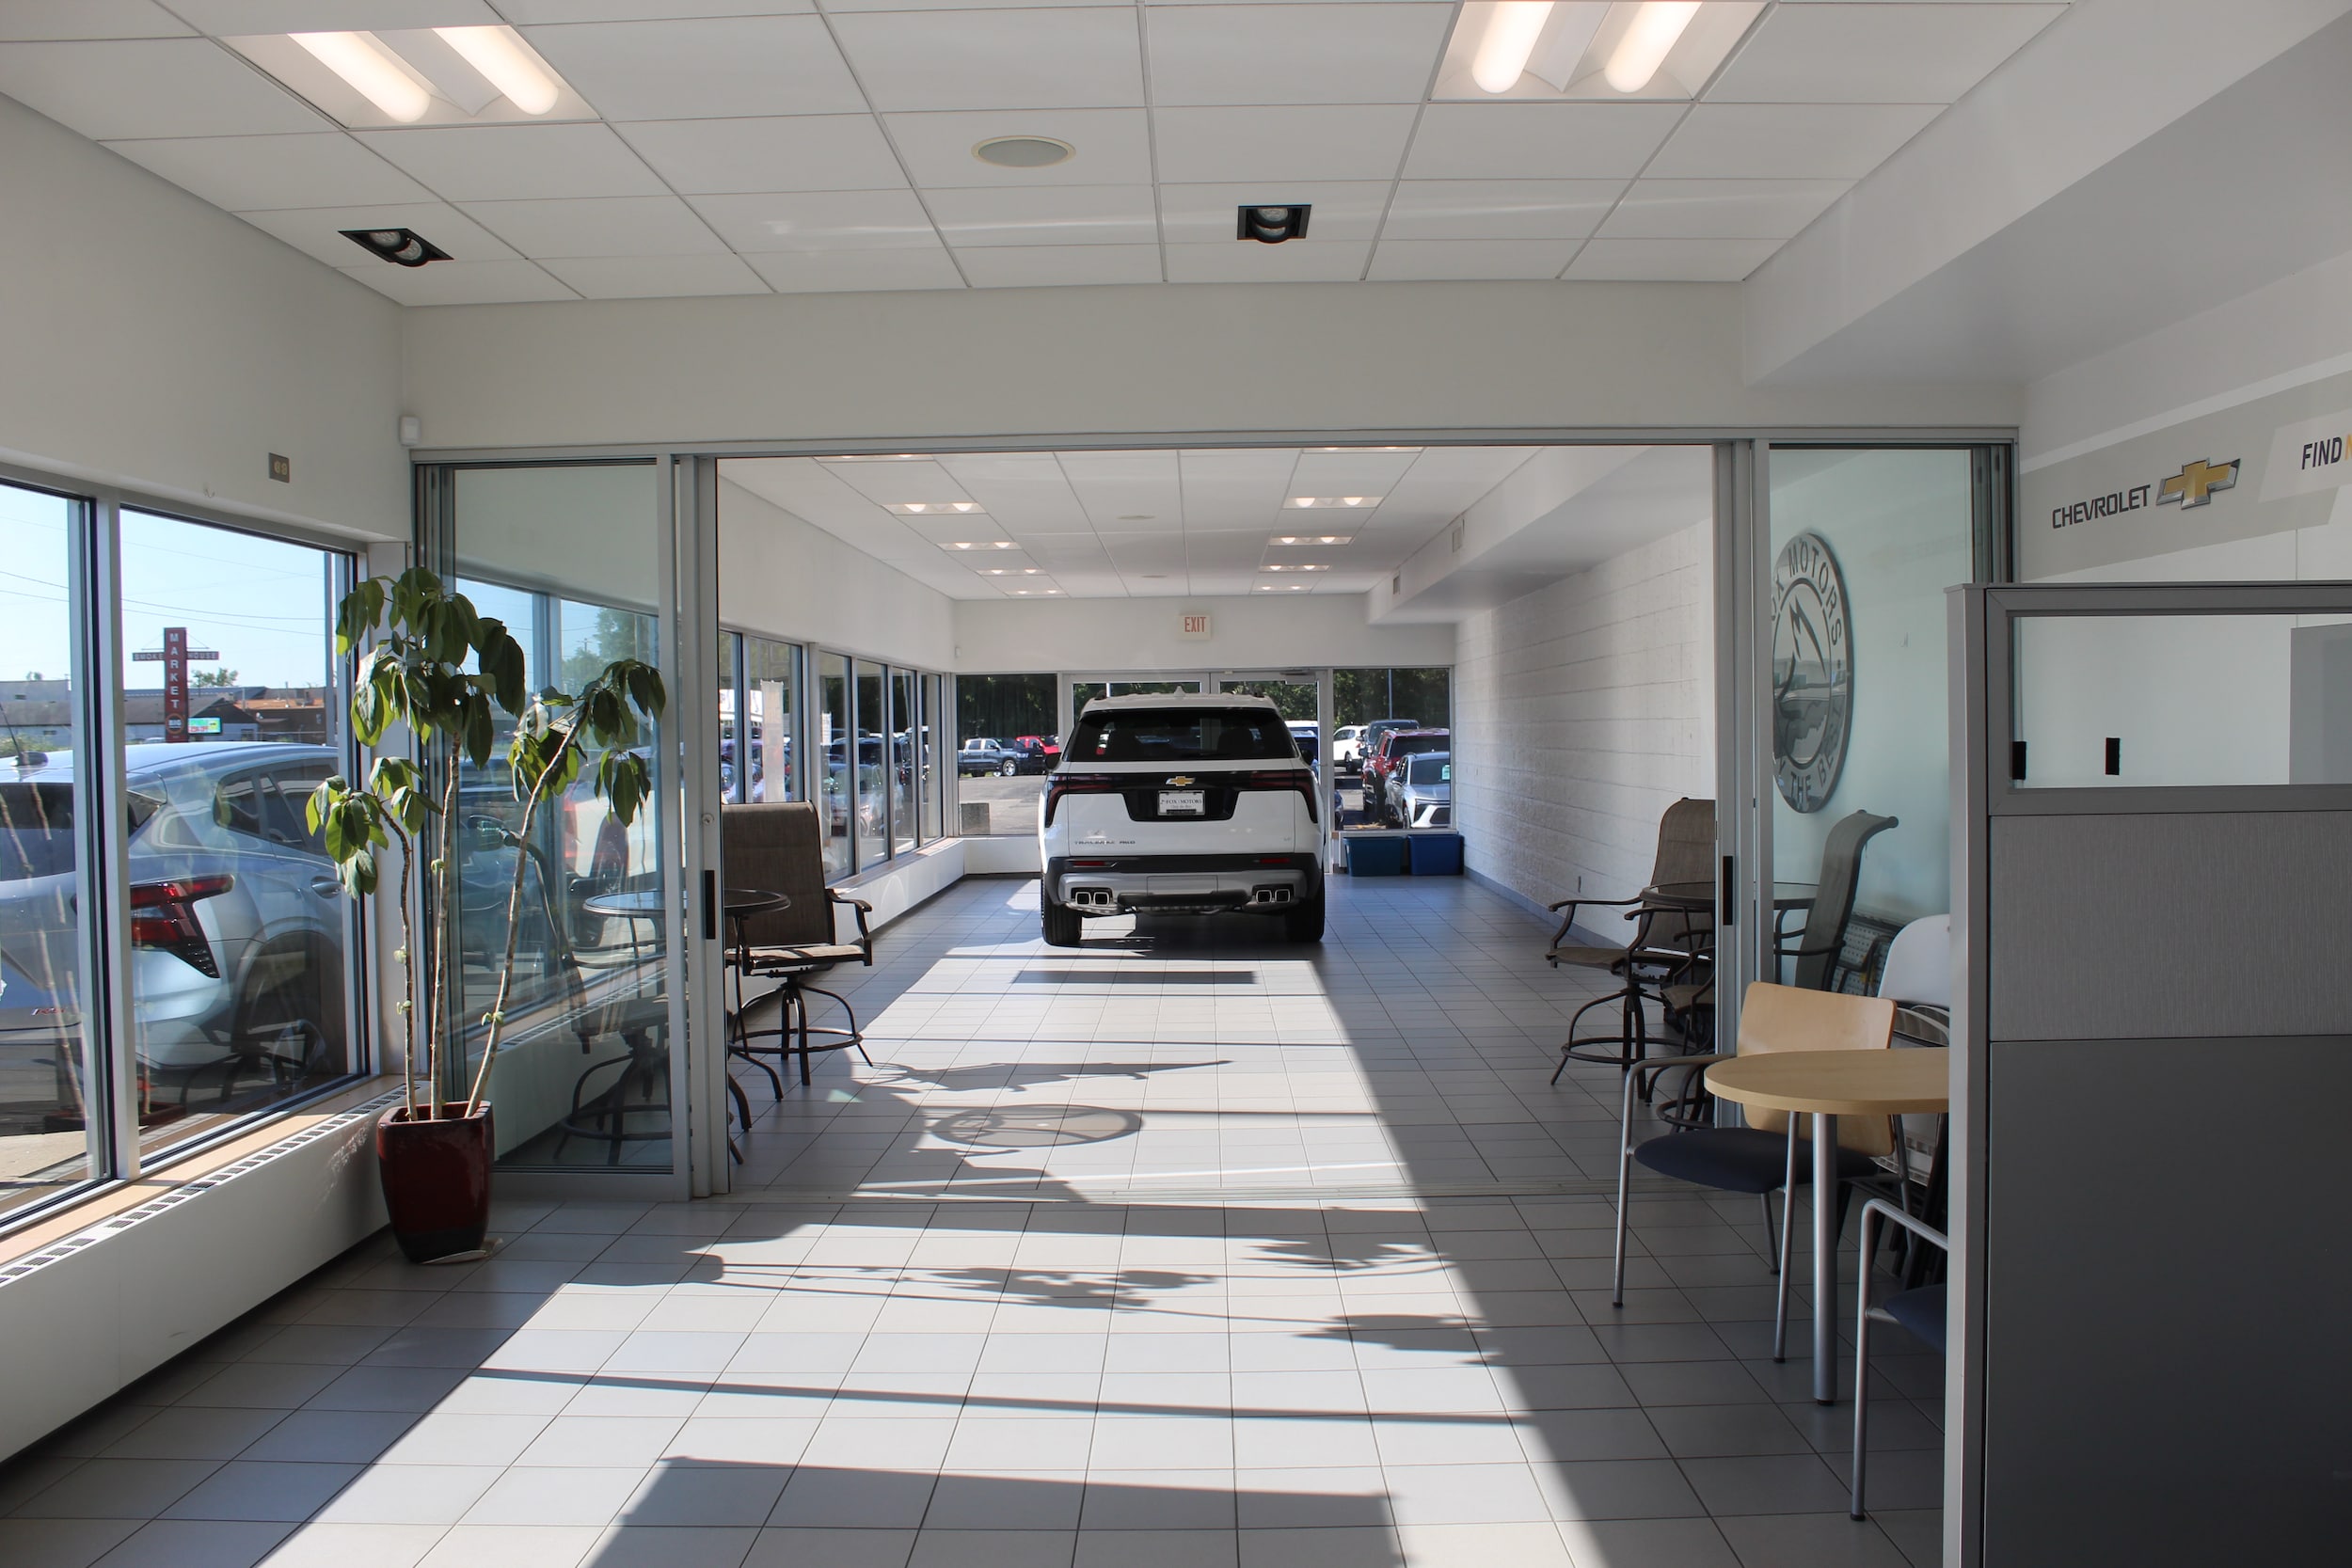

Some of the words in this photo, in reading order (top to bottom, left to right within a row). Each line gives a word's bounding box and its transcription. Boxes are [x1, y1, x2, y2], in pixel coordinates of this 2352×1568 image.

[2301, 436, 2343, 470] FIND
[2052, 484, 2151, 529] CHEVROLET
[1788, 541, 1842, 646] MOTORS
[1184, 616, 1206, 633] EXIT
[169, 633, 180, 708] MARKET
[1790, 771, 1811, 814] THE
